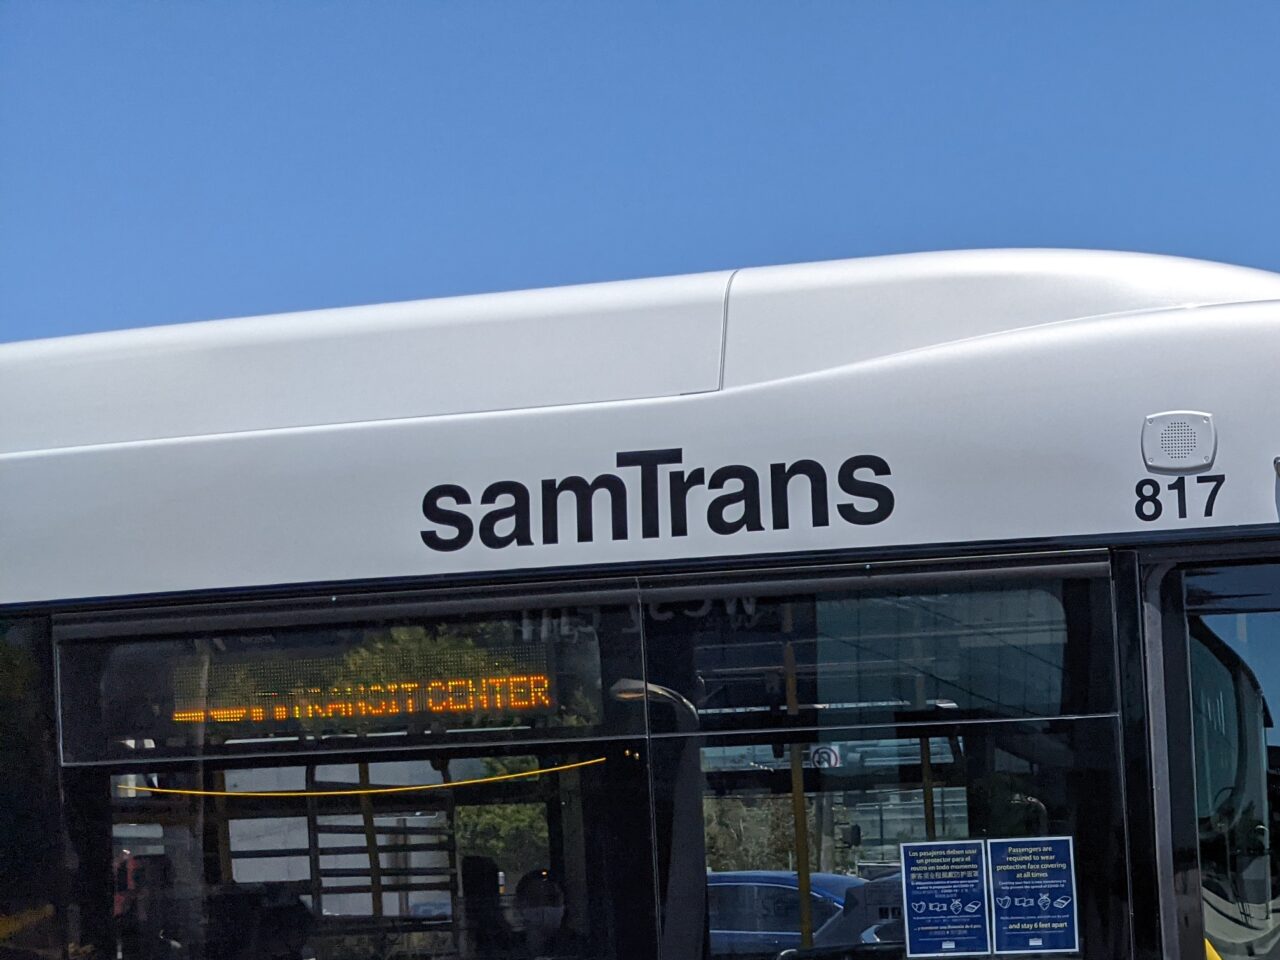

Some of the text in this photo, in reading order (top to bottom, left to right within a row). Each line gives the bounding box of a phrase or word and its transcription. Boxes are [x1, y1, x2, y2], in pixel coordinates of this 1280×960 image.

[418, 447, 897, 553] samTrans
[1132, 473, 1227, 523] 817
[427, 675, 551, 710] CENTER
[1008, 846, 1041, 854] Passengers
[924, 857, 951, 865] protector
[996, 863, 1026, 871] protective
[1021, 922, 1033, 930] stay
